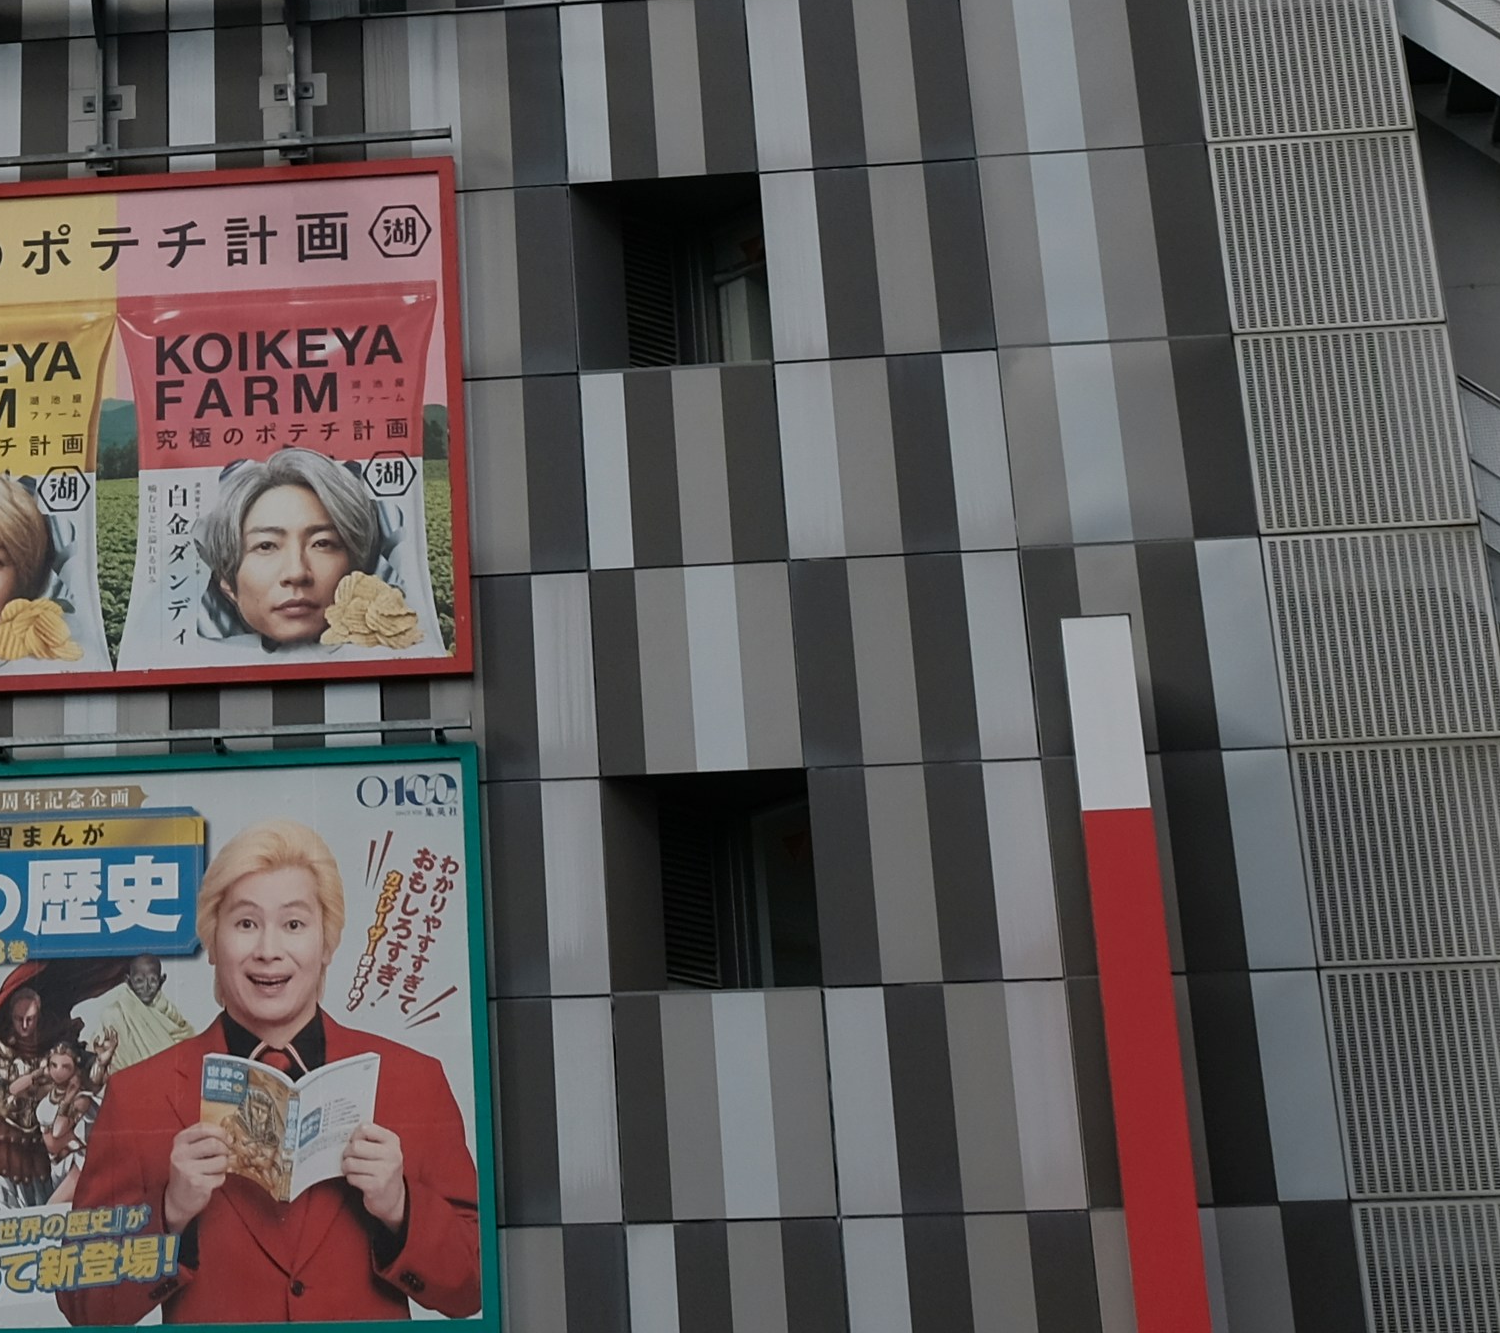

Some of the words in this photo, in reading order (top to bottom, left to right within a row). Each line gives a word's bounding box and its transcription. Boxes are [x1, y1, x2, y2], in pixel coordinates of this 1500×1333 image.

[383, 216, 417, 247] 湖
[155, 323, 404, 376] KOIKEYA
[29, 393, 83, 407] 湖池屋
[155, 371, 338, 421] FARM
[352, 394, 405, 406] ファーム
[29, 409, 82, 421] ファーム
[155, 417, 409, 451] 究極のポテチ計画
[47, 473, 78, 501] 湖
[375, 461, 405, 487] 湖
[166, 483, 192, 646] 白金ダンディ
[369, 846, 438, 1009] おもしろすぎ！
[398, 854, 460, 1015] わかりやすすぎて
